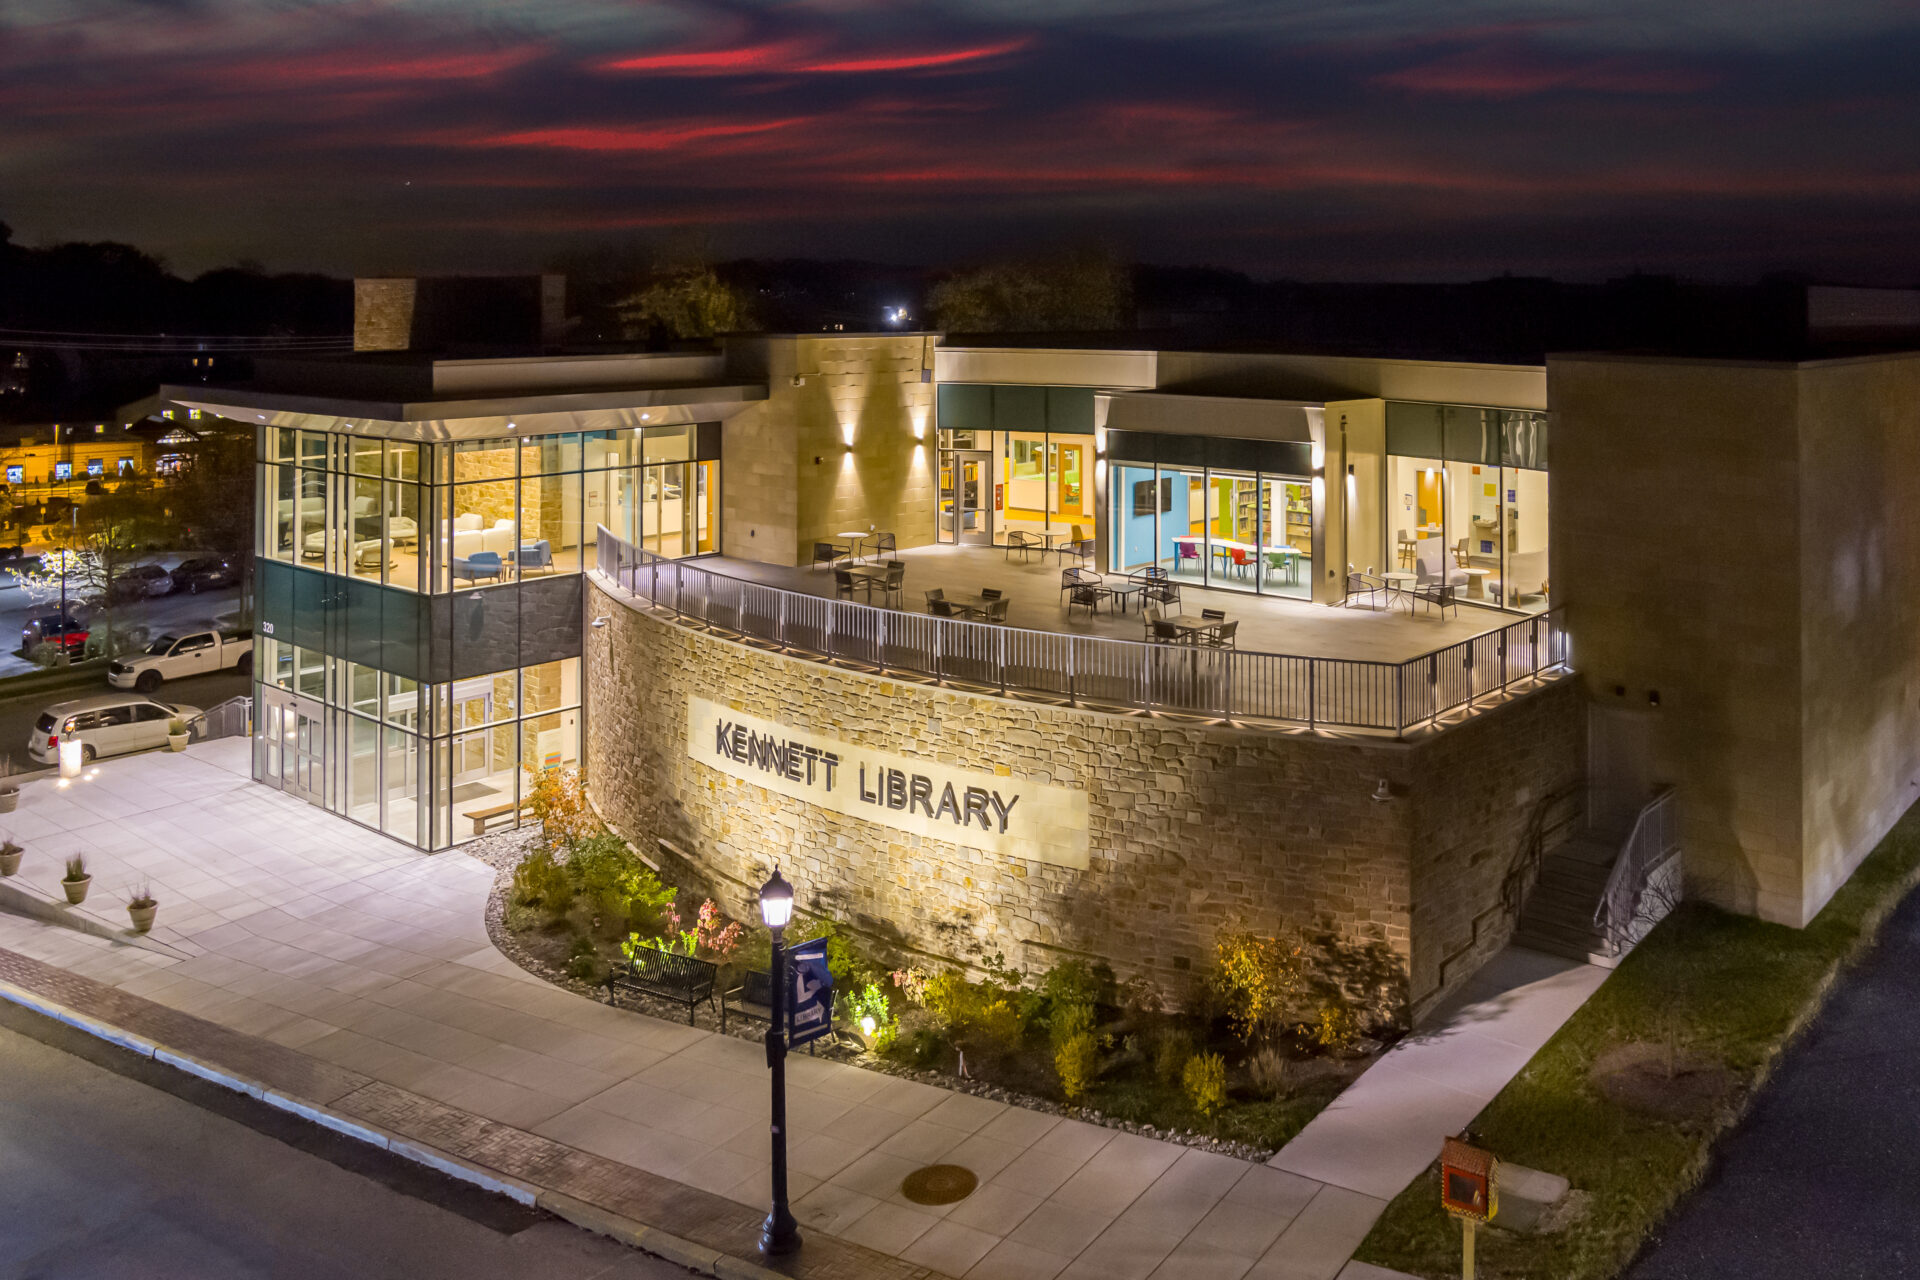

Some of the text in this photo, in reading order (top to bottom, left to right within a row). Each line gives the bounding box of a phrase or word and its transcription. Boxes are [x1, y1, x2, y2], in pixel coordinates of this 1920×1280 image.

[262, 621, 274, 634] 320
[716, 719, 1020, 835] KENNETT LIBRARY
[796, 1007, 822, 1022] LIBRARY
